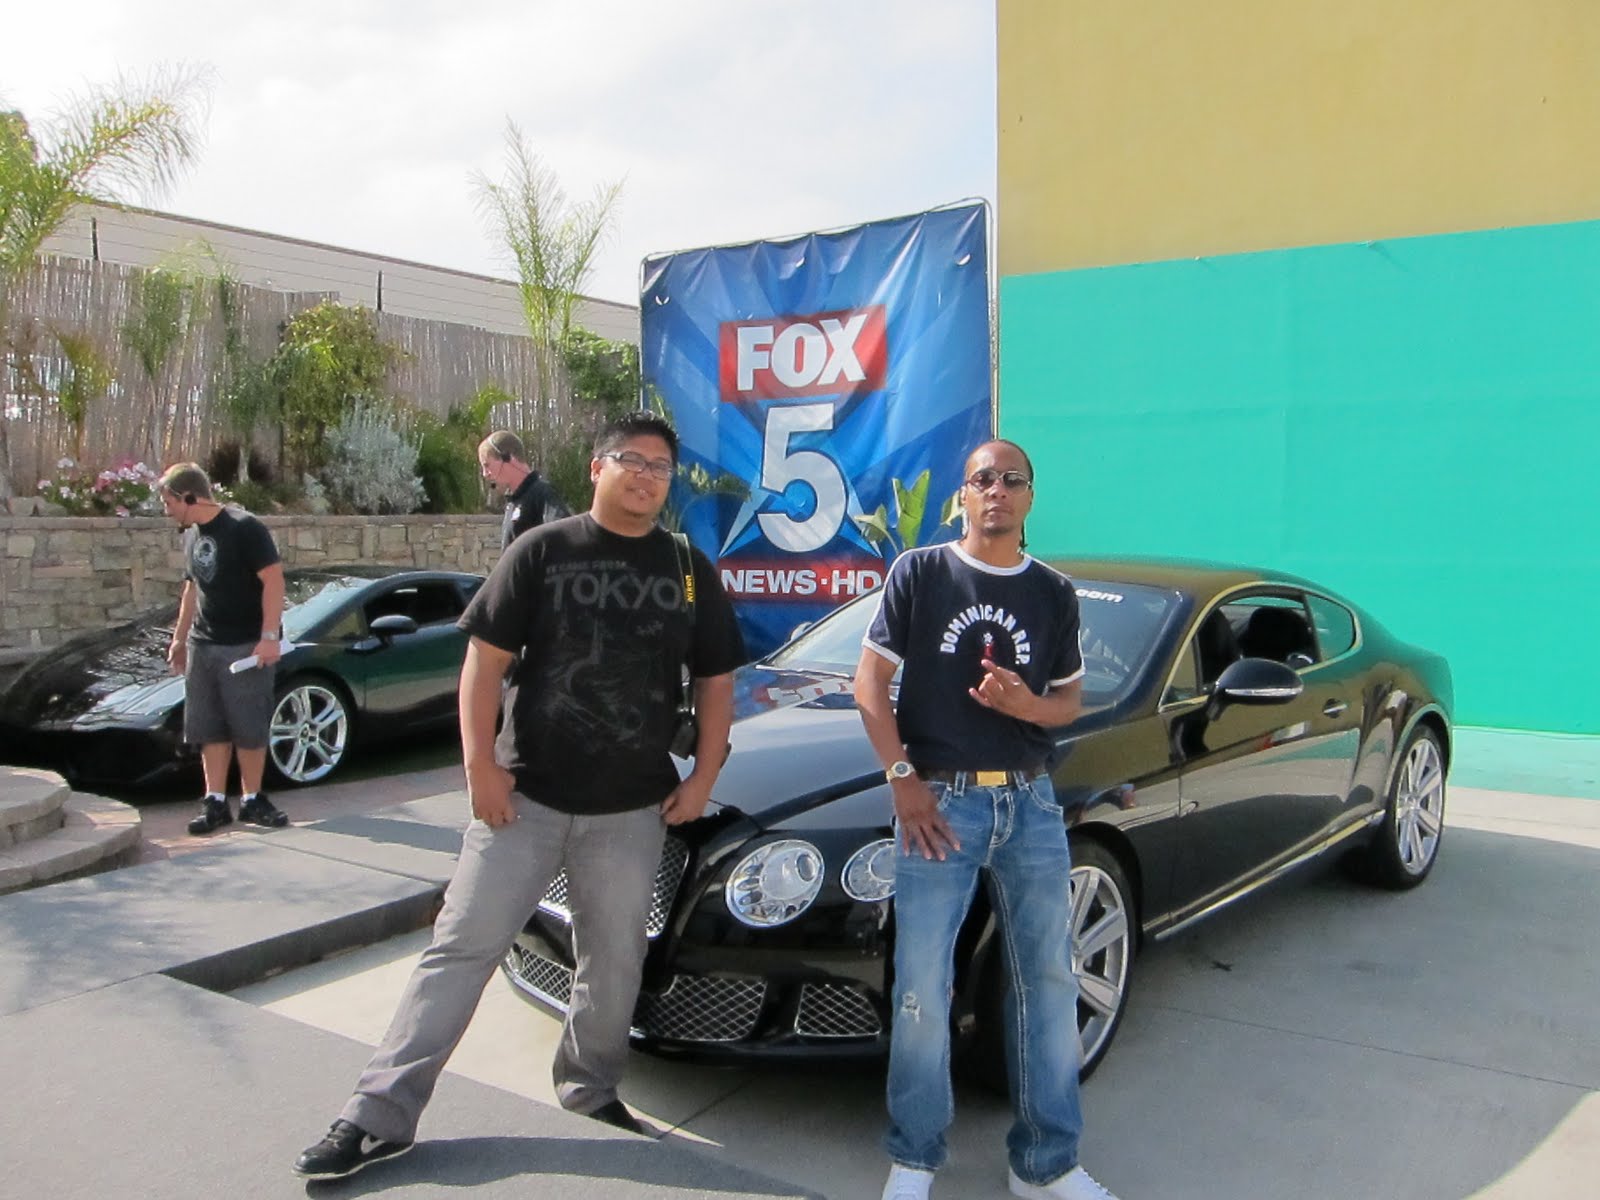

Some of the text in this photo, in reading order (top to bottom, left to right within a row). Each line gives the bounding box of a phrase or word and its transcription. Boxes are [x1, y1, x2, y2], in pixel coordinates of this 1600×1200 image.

[737, 314, 868, 391] FOX
[757, 402, 847, 553] 5
[940, 604, 1031, 665] DOMINICAN REP.
